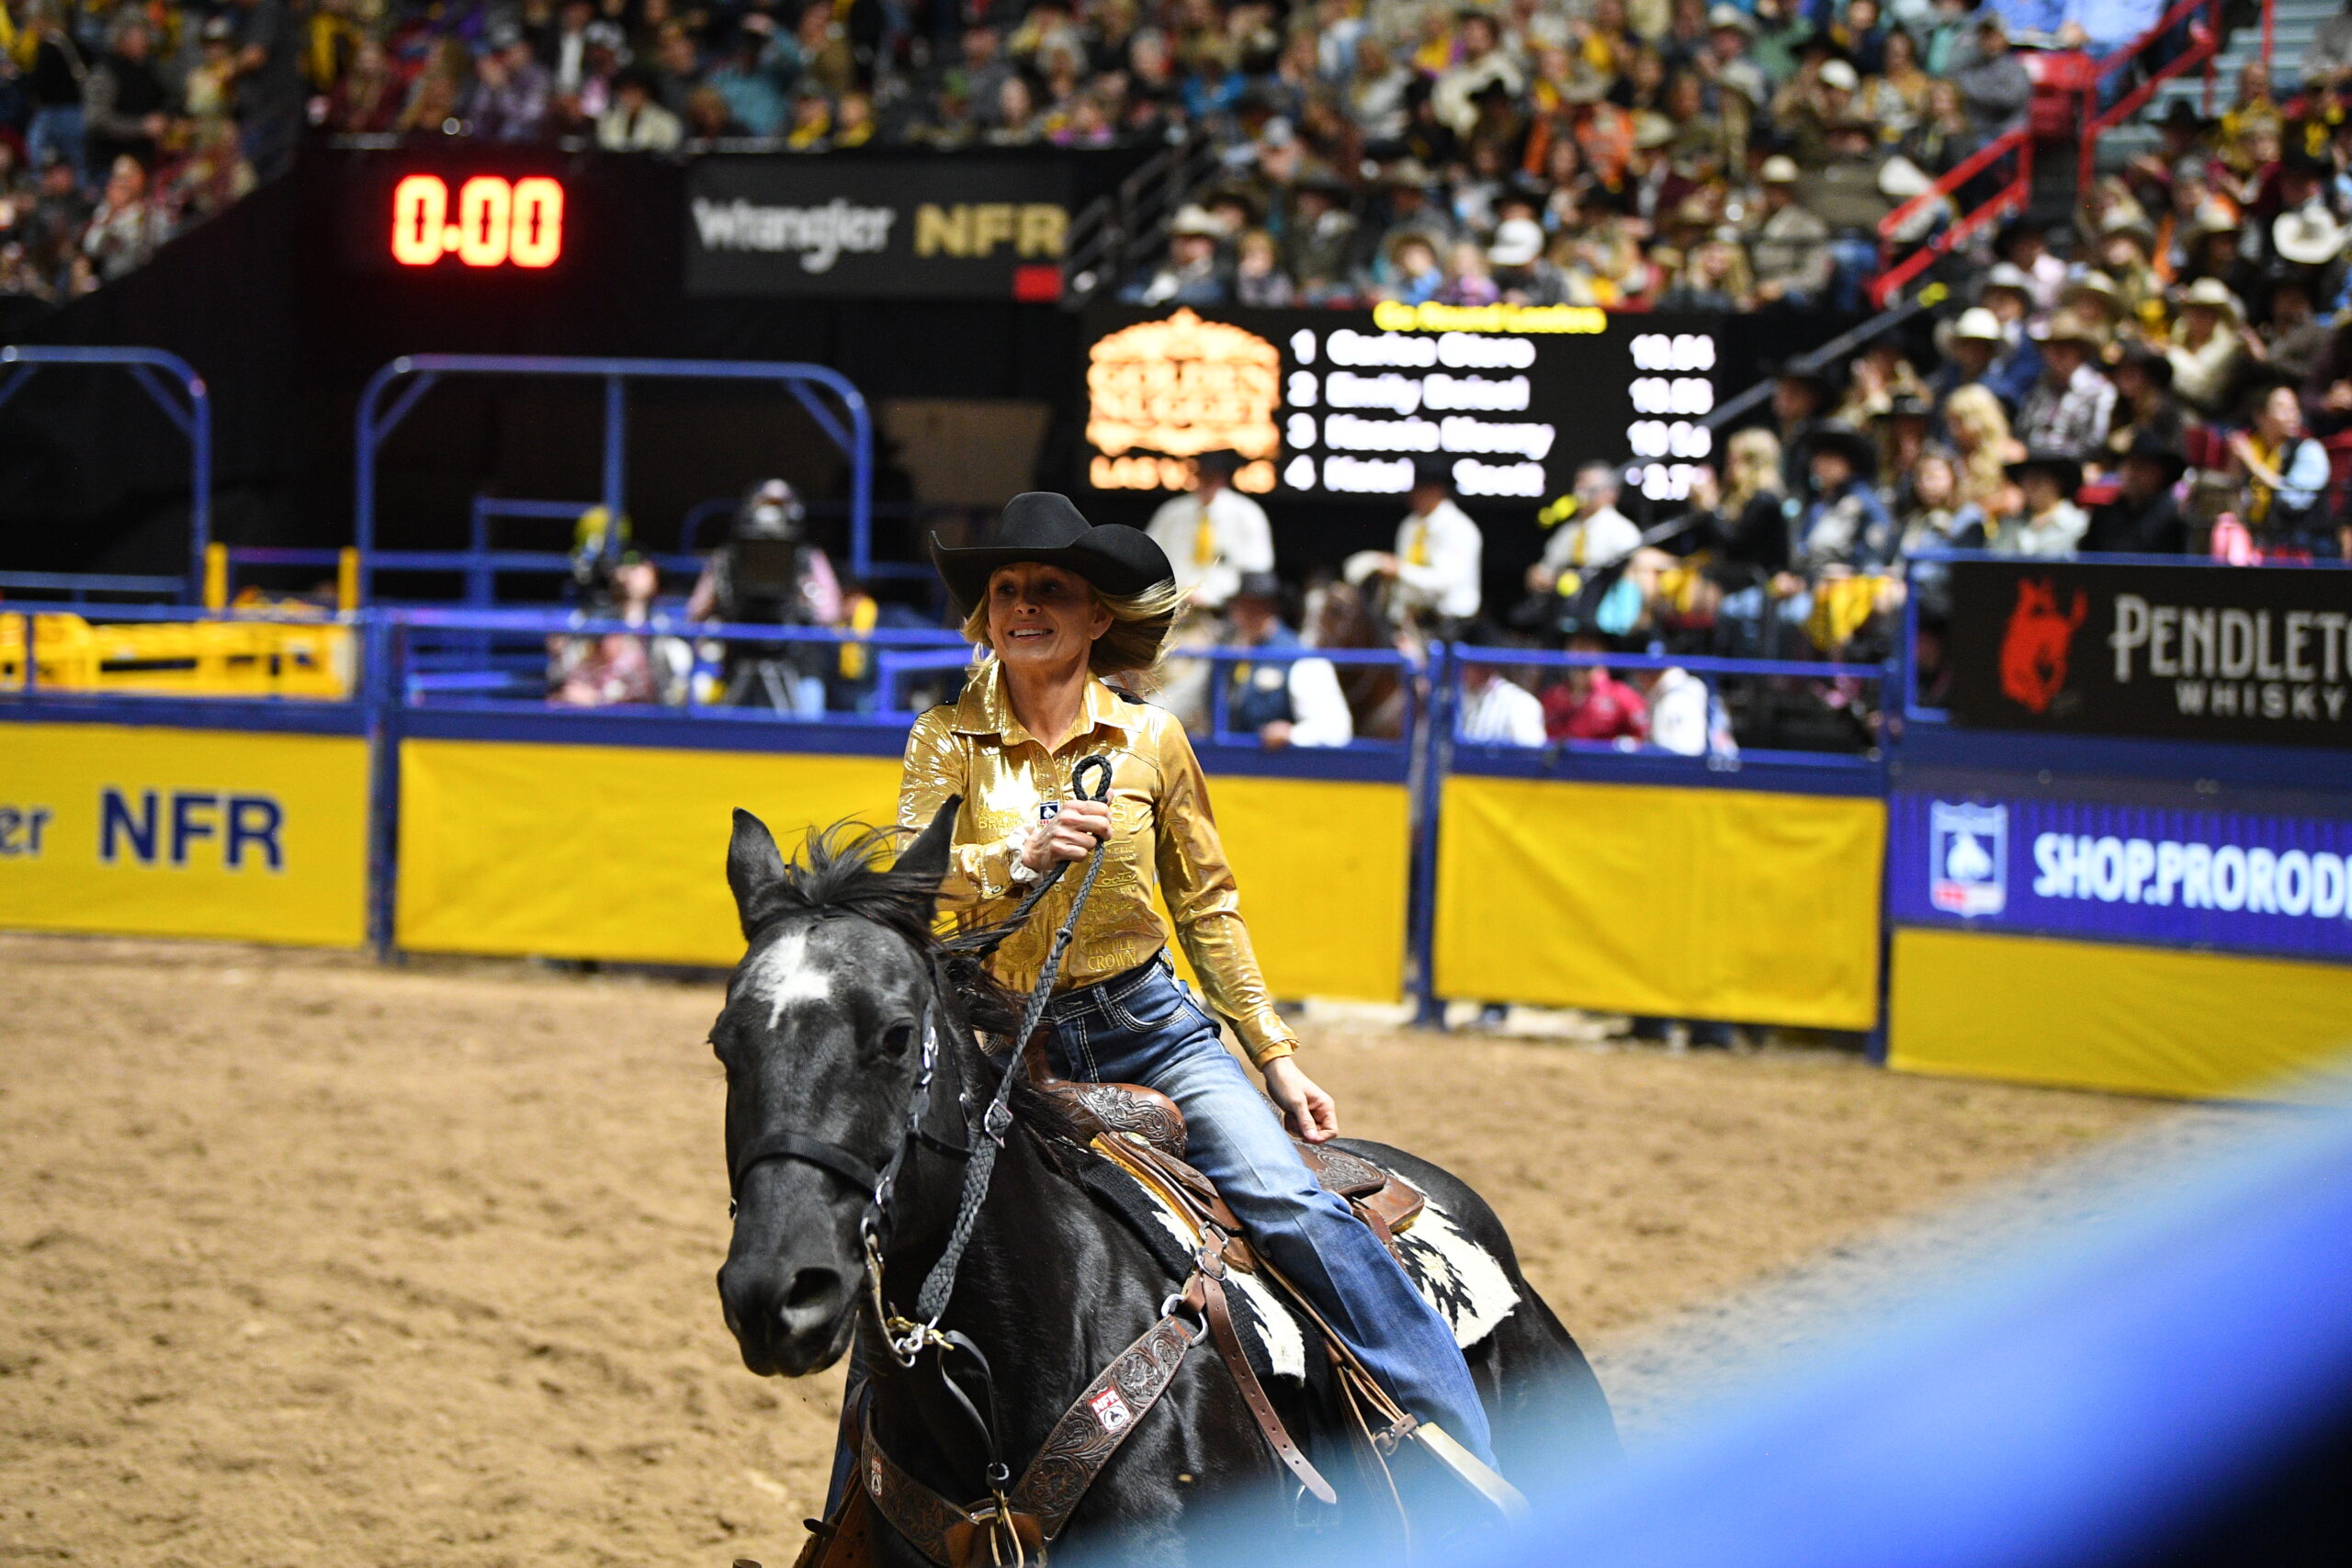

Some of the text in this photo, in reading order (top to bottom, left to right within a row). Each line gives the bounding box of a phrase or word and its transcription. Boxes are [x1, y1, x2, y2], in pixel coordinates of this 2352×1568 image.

[392, 175, 563, 268] 0.00
[692, 197, 1069, 274] Wrangler NFR
[2110, 593, 2352, 684] PENDLET
[2176, 680, 2347, 721] WHISKY
[98, 786, 285, 873] NFR
[2033, 831, 2352, 921] SHOP.PROROD
[1087, 950, 1137, 971] CROWN
[1091, 1390, 1120, 1414] NFR
